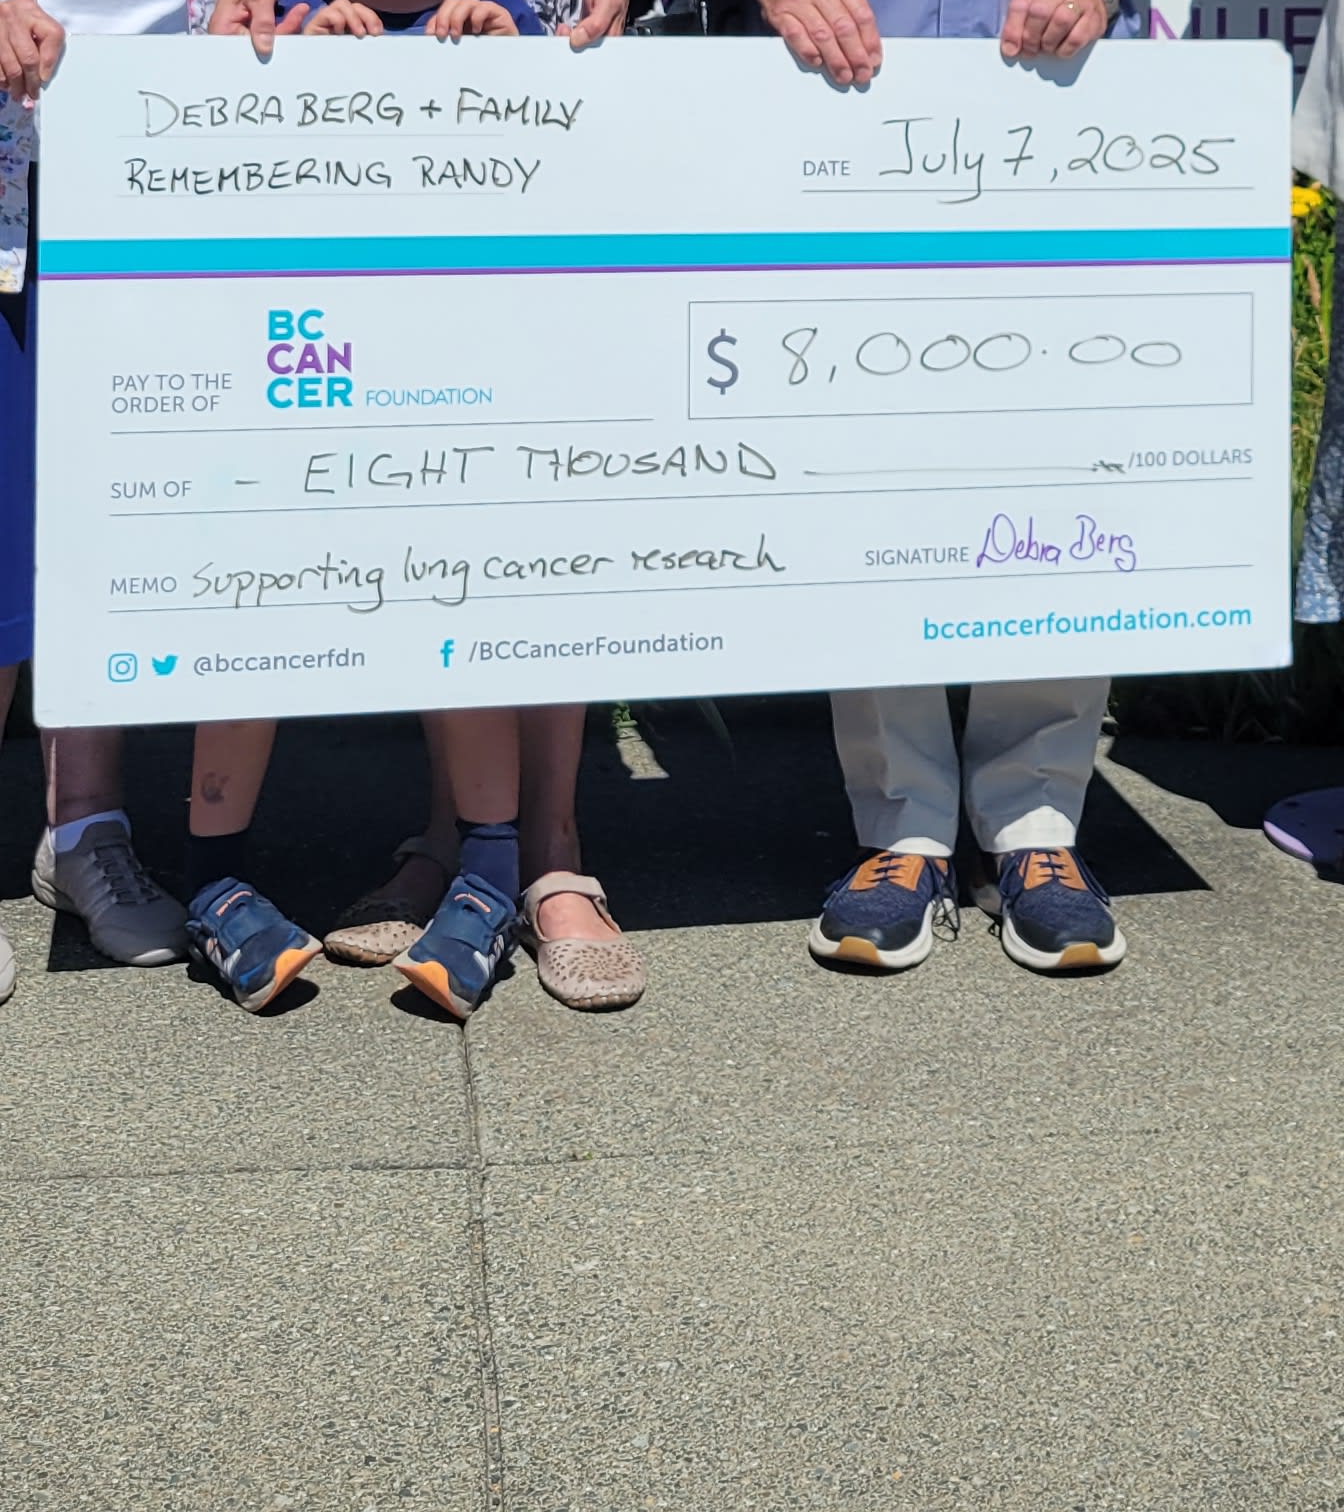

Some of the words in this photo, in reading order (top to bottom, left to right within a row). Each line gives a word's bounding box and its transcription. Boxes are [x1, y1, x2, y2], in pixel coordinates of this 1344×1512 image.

[138, 91, 284, 137] DEBRA
[297, 92, 404, 127] BERG
[457, 88, 583, 131] FAMILY
[125, 158, 391, 195] REMEMBERING
[412, 156, 540, 193] RANDY
[804, 161, 850, 176] DATE
[877, 118, 984, 204] July
[267, 308, 325, 341] BC
[267, 343, 351, 375] CAN
[707, 328, 738, 395] $
[113, 375, 149, 391] PAY
[155, 374, 184, 390] TO
[191, 373, 232, 389] THE
[266, 376, 353, 409] CER
[366, 388, 491, 406] FOUNDATION
[112, 396, 184, 413] ORDER
[194, 395, 219, 411] OF
[304, 447, 494, 494] EIGHT
[517, 442, 776, 481] THOUSAND
[1129, 452, 1166, 467] /100
[1173, 449, 1251, 465] DOLLARS
[111, 482, 155, 498] SUM
[164, 481, 191, 497] OF
[866, 547, 968, 565] SIGNATURE
[976, 514, 1061, 568] Debra
[111, 577, 176, 594] MEMO
[401, 546, 472, 606] lung
[484, 555, 614, 579] cancer
[632, 534, 786, 572] research
[924, 608, 1252, 640] bccancerfoundation.com
[194, 648, 364, 676] @bccancerfdn
[469, 633, 722, 662] /BCCancerFoundation
